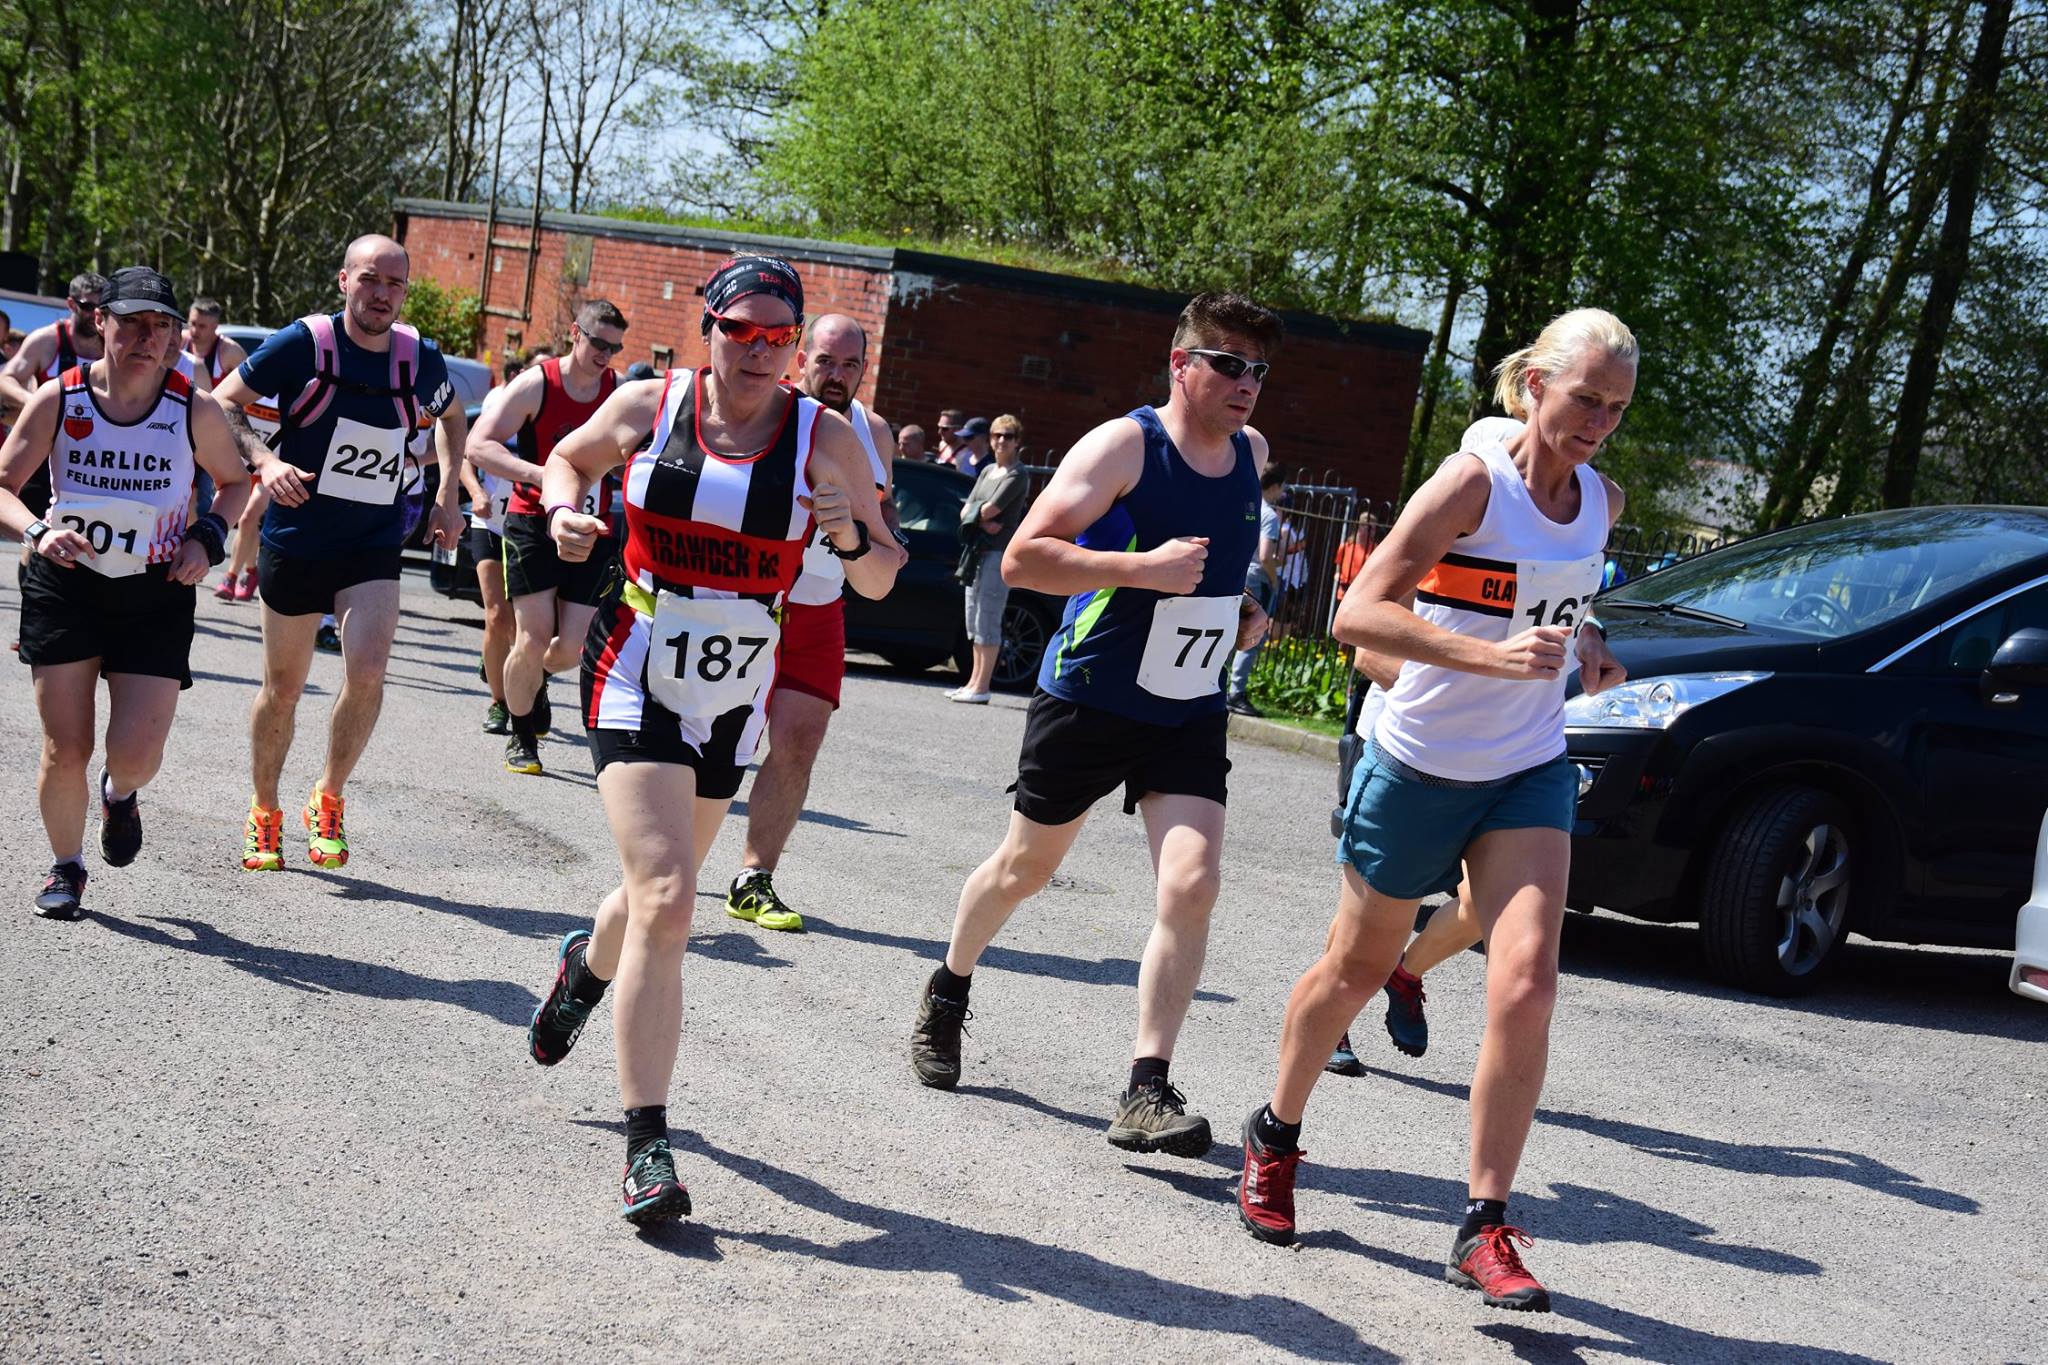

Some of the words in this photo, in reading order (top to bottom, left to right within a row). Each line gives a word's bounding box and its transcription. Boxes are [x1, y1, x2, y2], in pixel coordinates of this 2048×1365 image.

[66, 469, 171, 491] FELLRUNNERS
[69, 450, 172, 472] BARLICK
[331, 444, 400, 482] 224
[61, 515, 137, 555] 201
[644, 524, 750, 578] TRAWDEN
[665, 631, 769, 682] 187
[1174, 626, 1225, 669] 77
